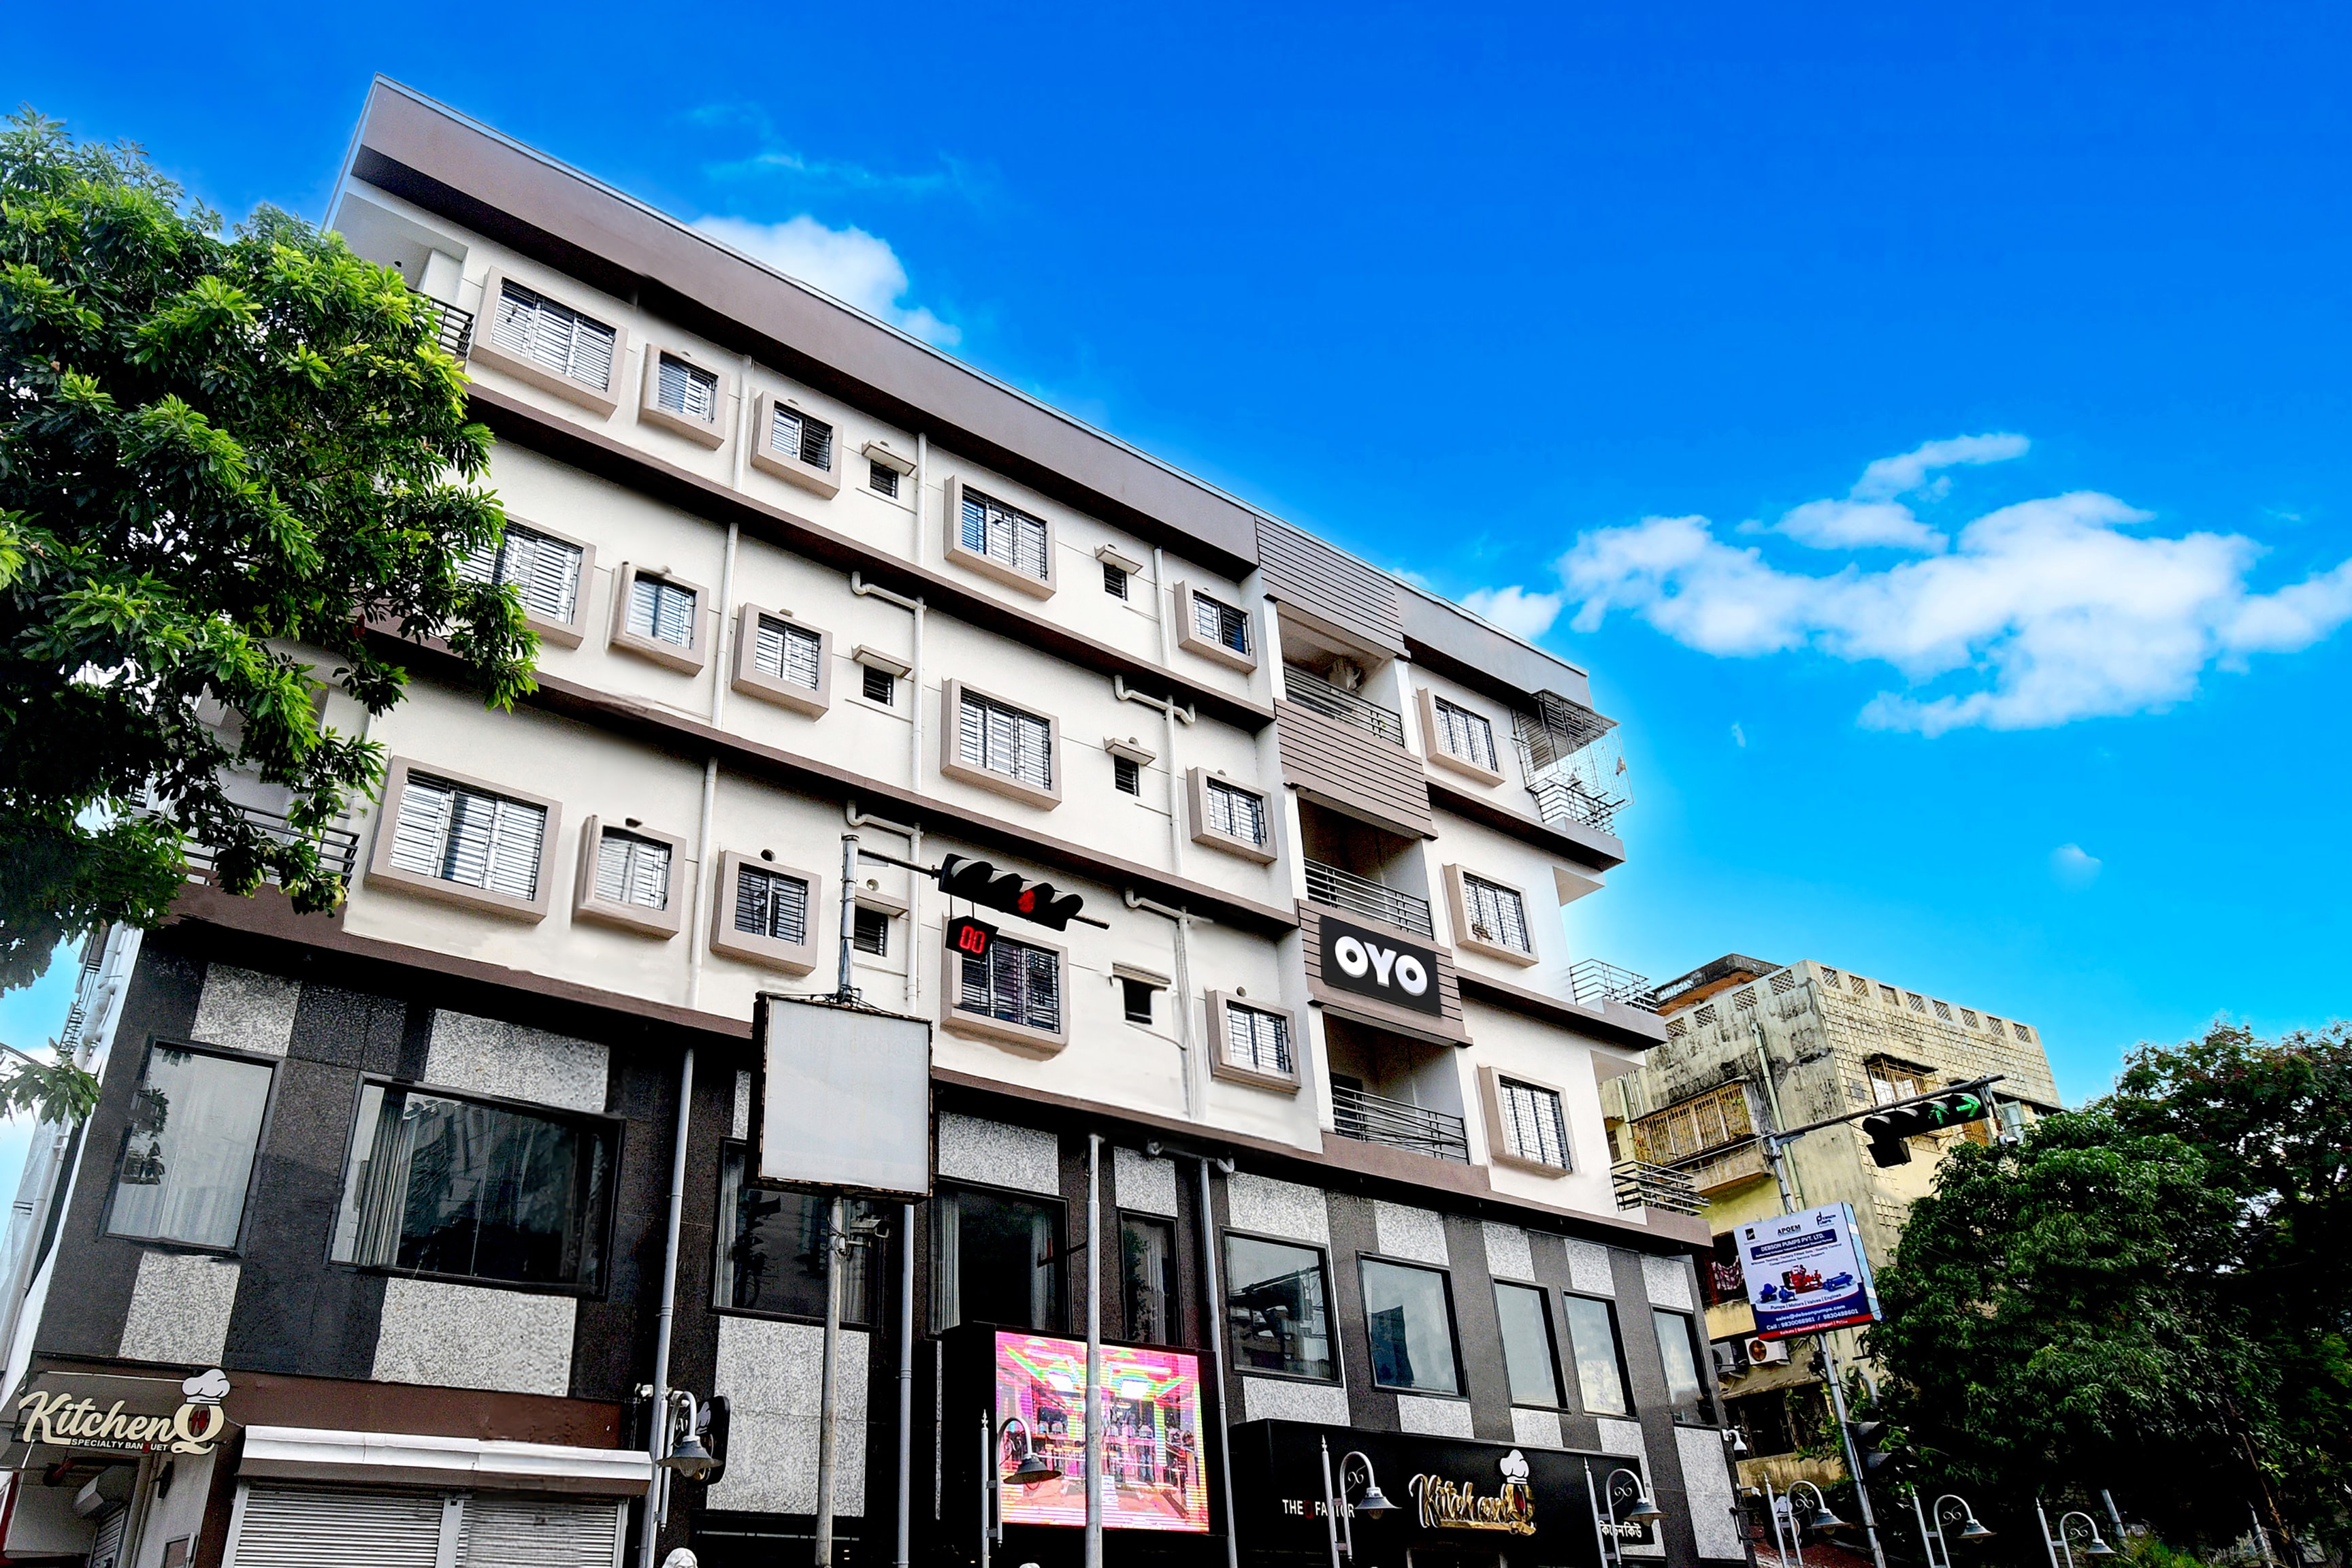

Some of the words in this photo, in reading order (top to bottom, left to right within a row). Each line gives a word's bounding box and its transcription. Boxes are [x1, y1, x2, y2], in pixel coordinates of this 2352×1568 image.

[959, 925, 985, 954] 00
[1335, 936, 1428, 996] OYO
[1777, 1224, 1801, 1235] APOEM
[1782, 1238, 1801, 1247] PUMPS
[71, 1438, 124, 1448] SPECIALTY
[1282, 1499, 1304, 1515] THE
[1315, 1501, 1355, 1518] FATR
